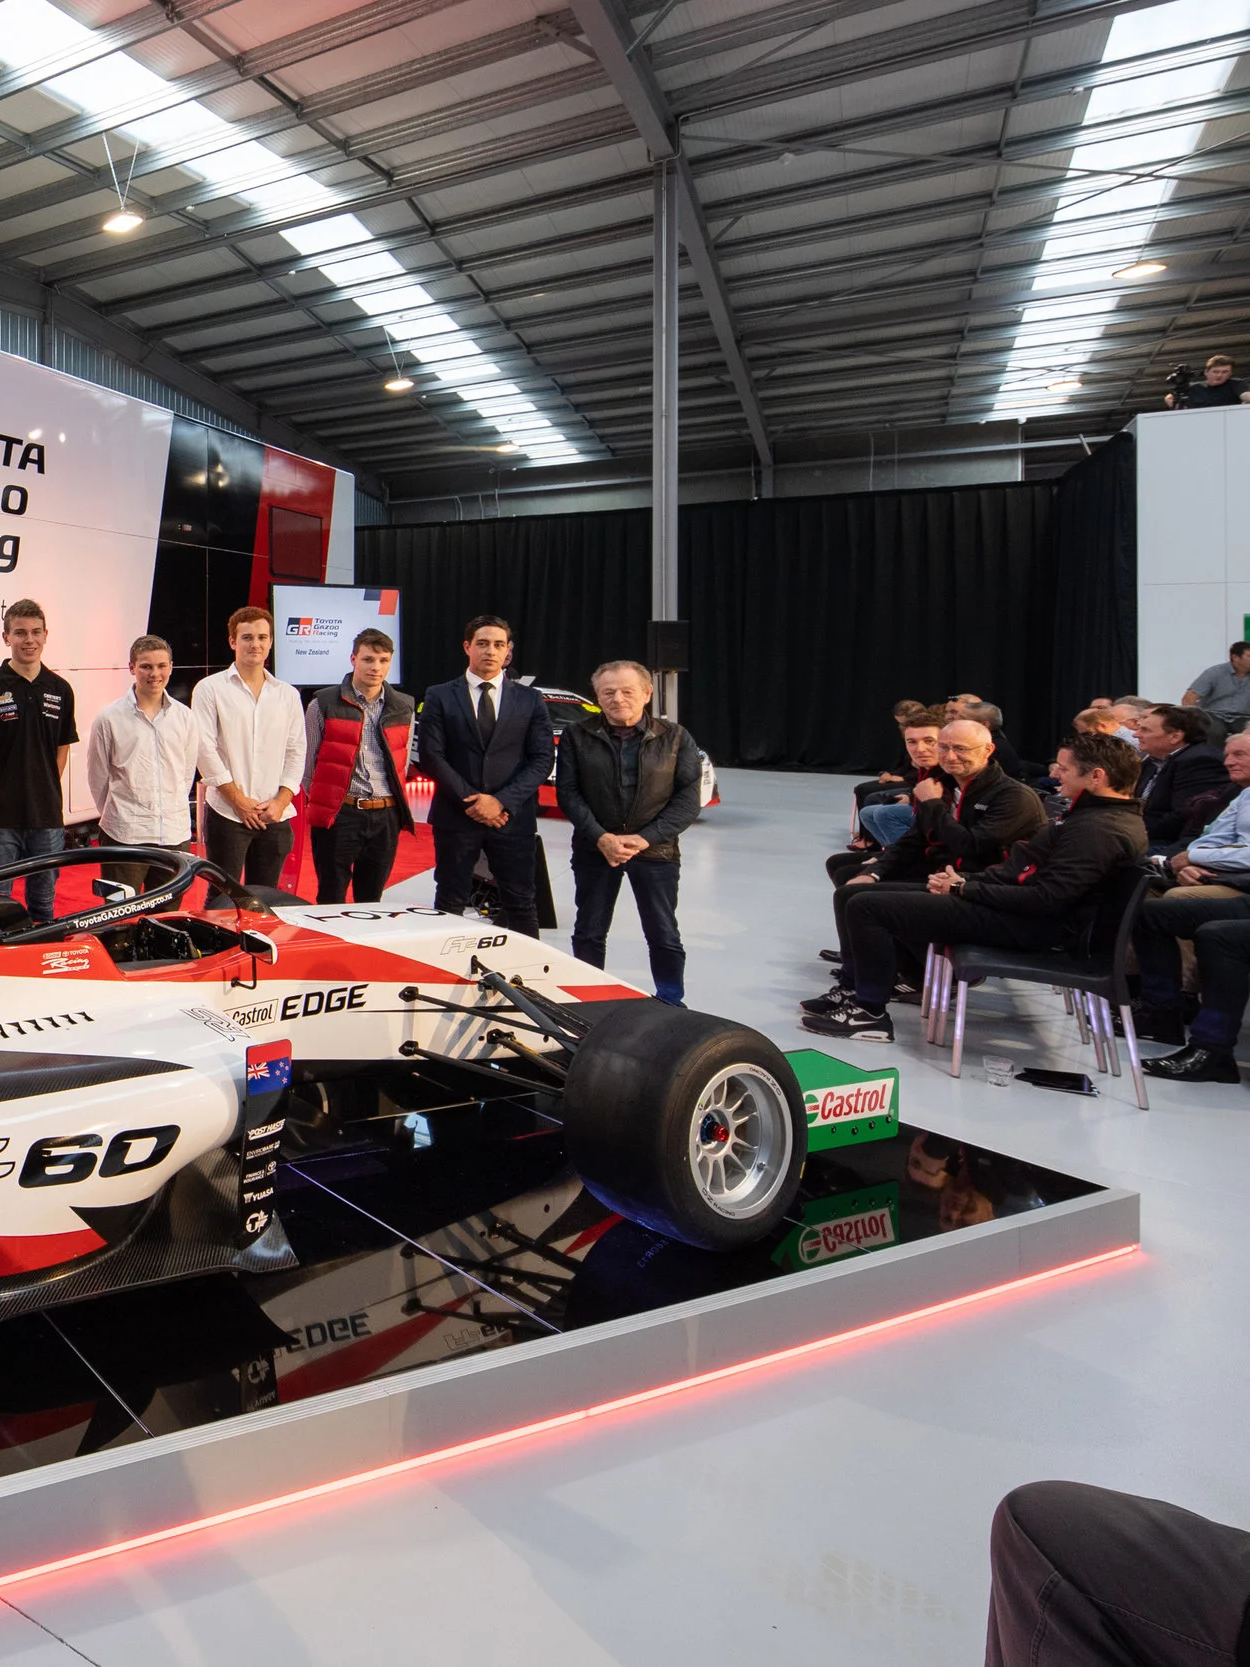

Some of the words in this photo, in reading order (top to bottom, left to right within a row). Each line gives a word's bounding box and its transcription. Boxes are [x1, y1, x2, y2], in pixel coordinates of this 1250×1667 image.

[287, 624, 312, 636] GR
[73, 893, 174, 929] ToyotaGAZOORacing.co.nz
[232, 1003, 273, 1027] Castrol
[280, 984, 369, 1021] EDGE
[820, 1084, 888, 1120] Castrol
[253, 1187, 274, 1201] YUASA
